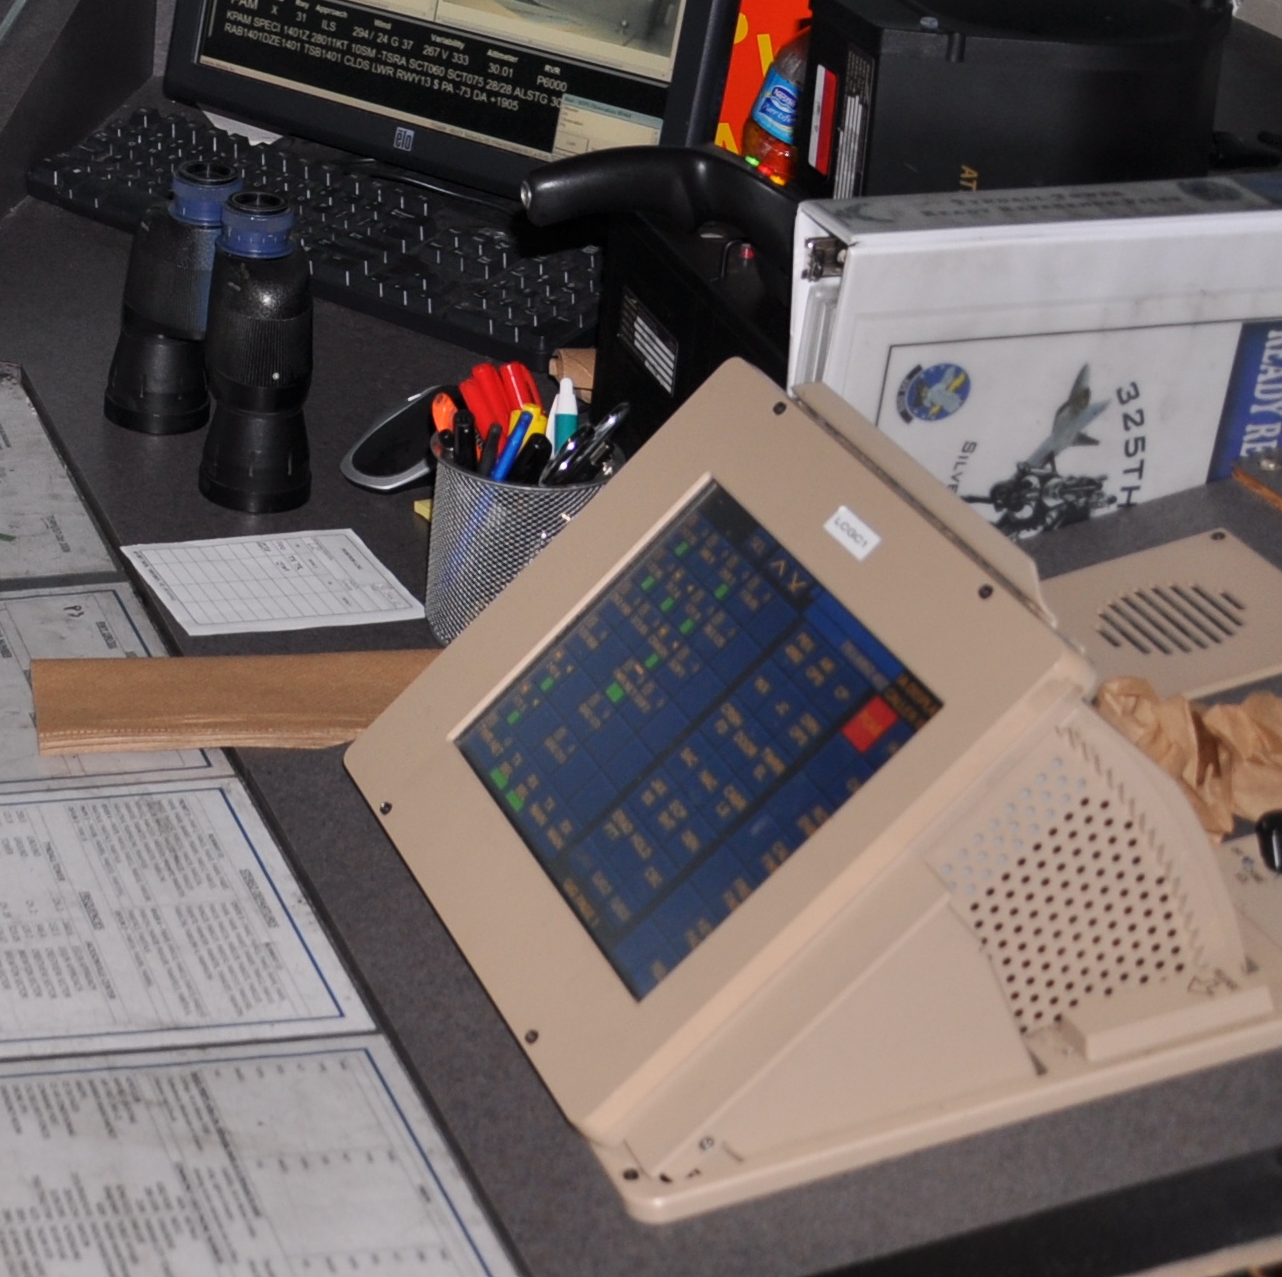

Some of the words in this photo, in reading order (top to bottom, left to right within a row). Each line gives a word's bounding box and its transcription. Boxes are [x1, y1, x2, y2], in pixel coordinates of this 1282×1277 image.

[271, 5, 278, 15] X
[295, 11, 307, 22] 31
[315, 4, 348, 18] Approach
[321, 19, 337, 32] ILS
[391, 35, 400, 46] G
[401, 38, 414, 51] 37
[430, 33, 465, 50] Variability
[226, 9, 252, 25] KPAM
[253, 17, 281, 33] SPECI
[283, 25, 310, 41] 1401Z
[351, 43, 376, 59] 10SM
[378, 49, 407, 67] -TSRA
[447, 69, 484, 87] SCT075
[514, 86, 548, 105] ALSTG
[440, 48, 449, 60] V
[451, 52, 470, 66] 333
[303, 43, 342, 63] TSB1401
[343, 54, 370, 71] CLDS
[371, 61, 395, 78] LWR
[396, 67, 431, 87] RWY13
[441, 82, 454, 94] PA
[472, 89, 487, 103] DA
[490, 96, 519, 111] +1905
[488, 62, 514, 78] 30.01
[536, 75, 568, 92] P6000
[1115, 381, 1146, 509] 325TH
[947, 440, 978, 492] SILVE
